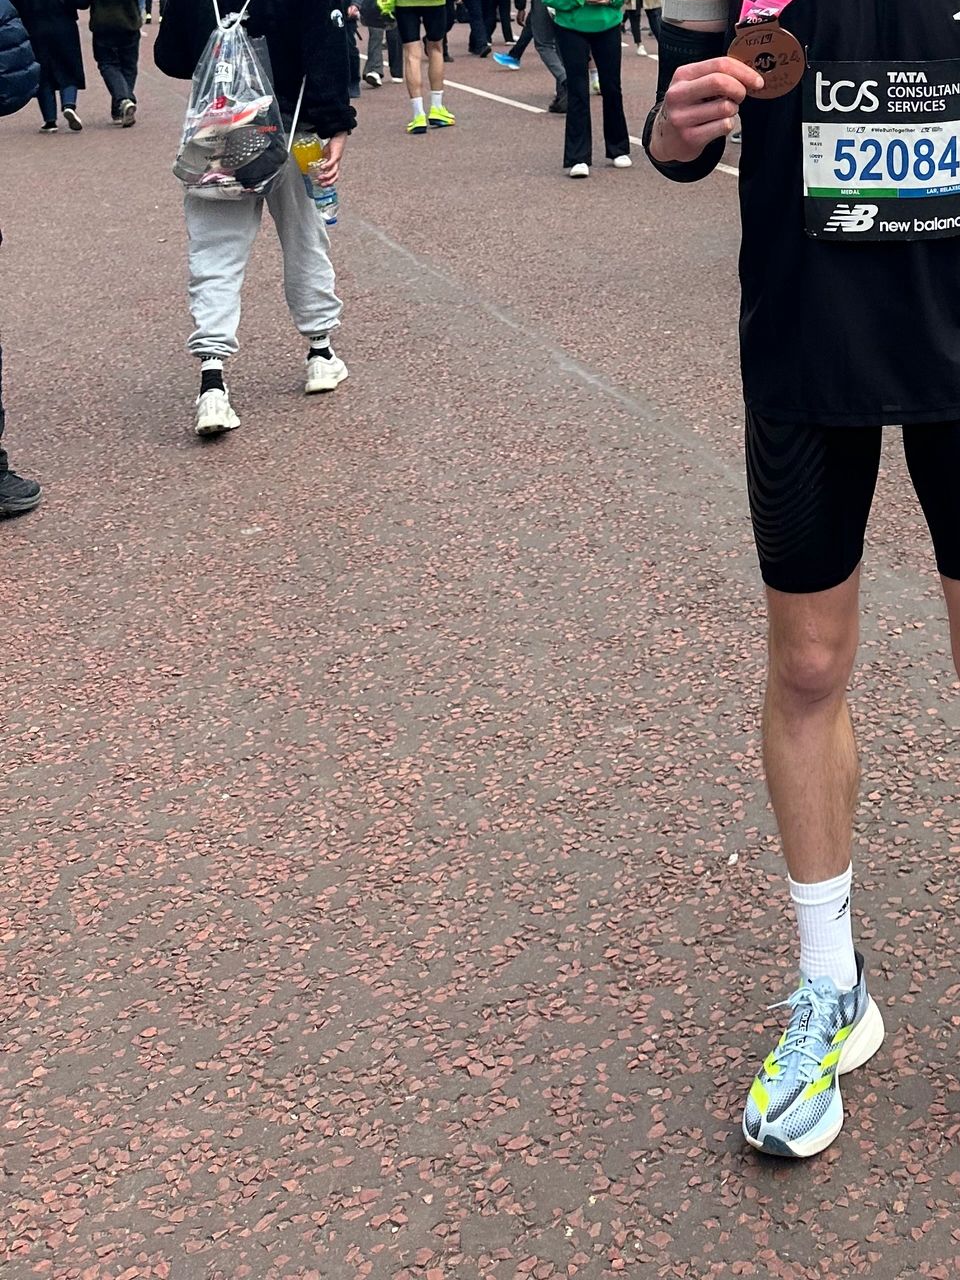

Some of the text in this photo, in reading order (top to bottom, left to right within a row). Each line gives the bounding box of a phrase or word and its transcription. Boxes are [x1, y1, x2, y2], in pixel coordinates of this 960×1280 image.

[887, 72, 928, 84] TATA
[816, 71, 880, 112] tcs
[887, 99, 946, 113] SERVICES
[834, 135, 960, 182] 52084
[879, 220, 910, 232] new
